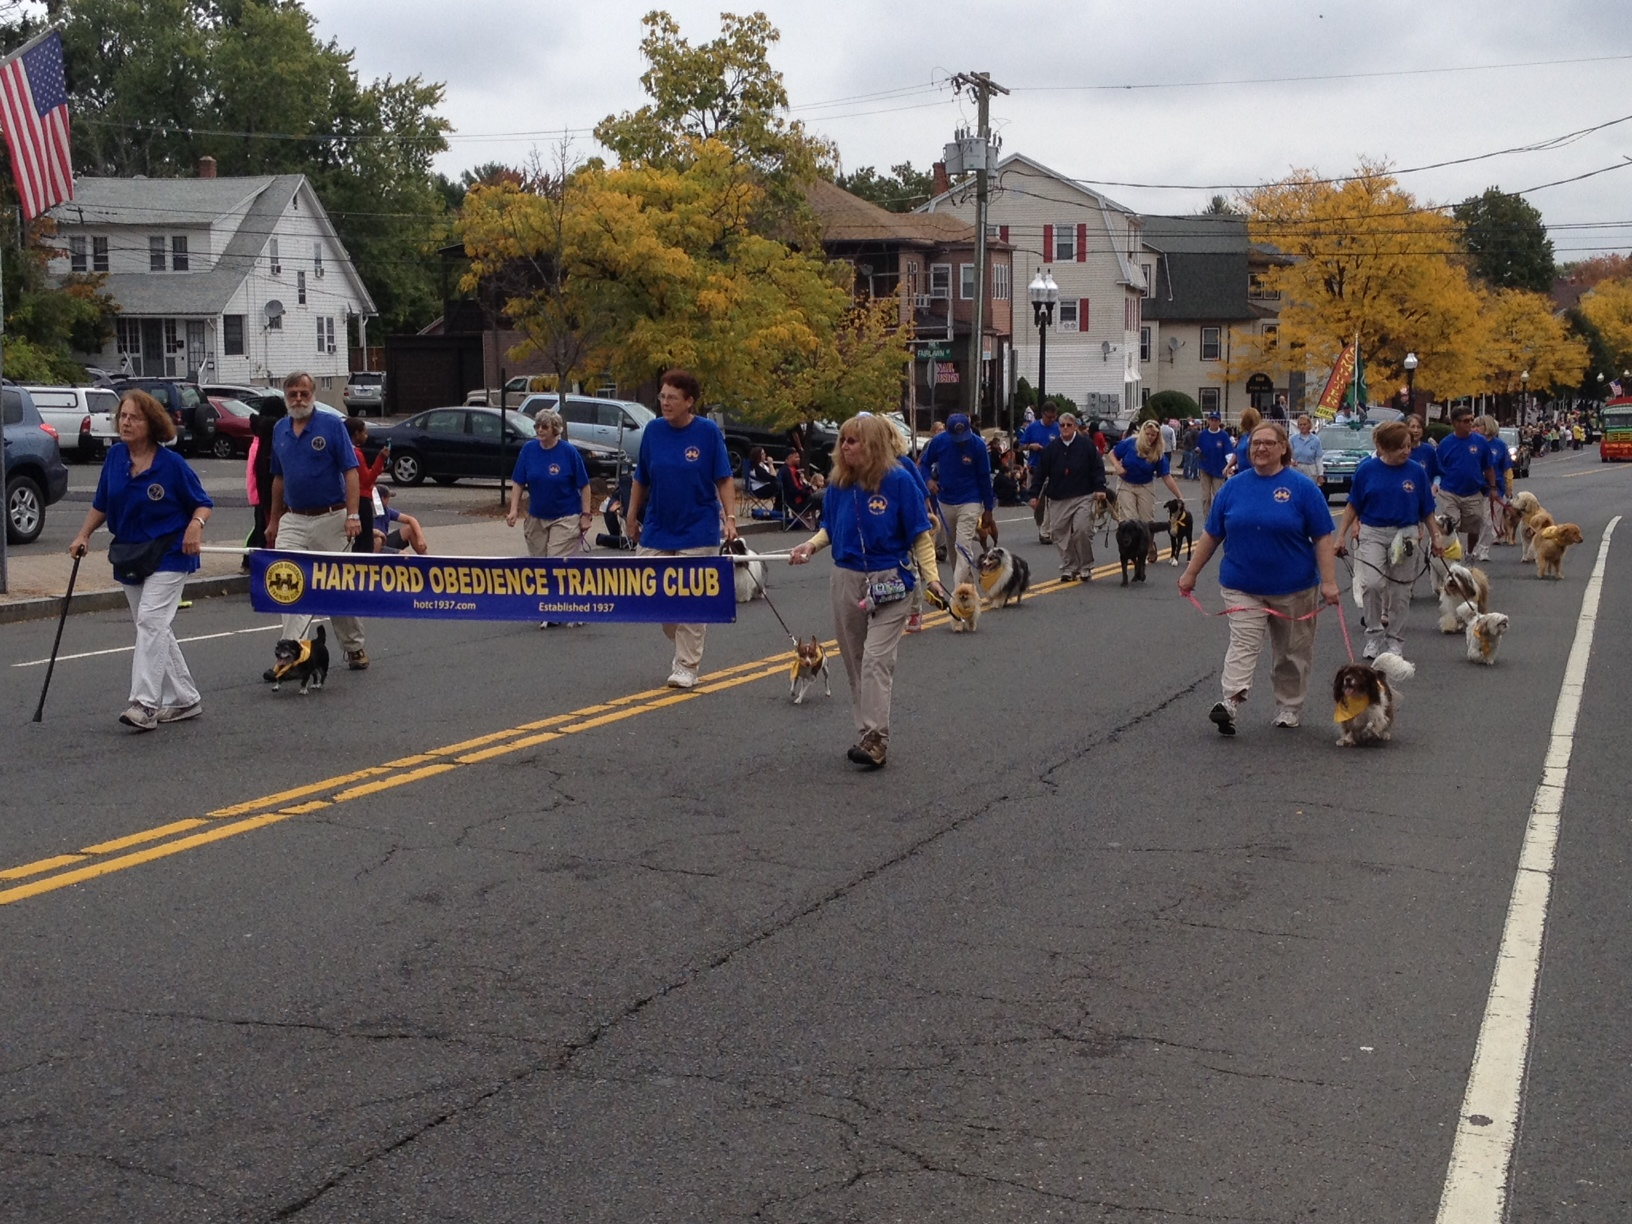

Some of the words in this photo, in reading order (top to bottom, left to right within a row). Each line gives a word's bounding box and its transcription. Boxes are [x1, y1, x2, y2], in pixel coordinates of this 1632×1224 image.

[937, 362, 955, 372] NAIL
[311, 562, 424, 593] HARTFORD
[428, 566, 549, 596] OBEDIENCE
[552, 567, 657, 597] TRAINING
[663, 567, 720, 597] CLUB
[413, 598, 476, 610] hotc1937.com
[538, 602, 590, 612] Established
[592, 603, 615, 613] 1937
